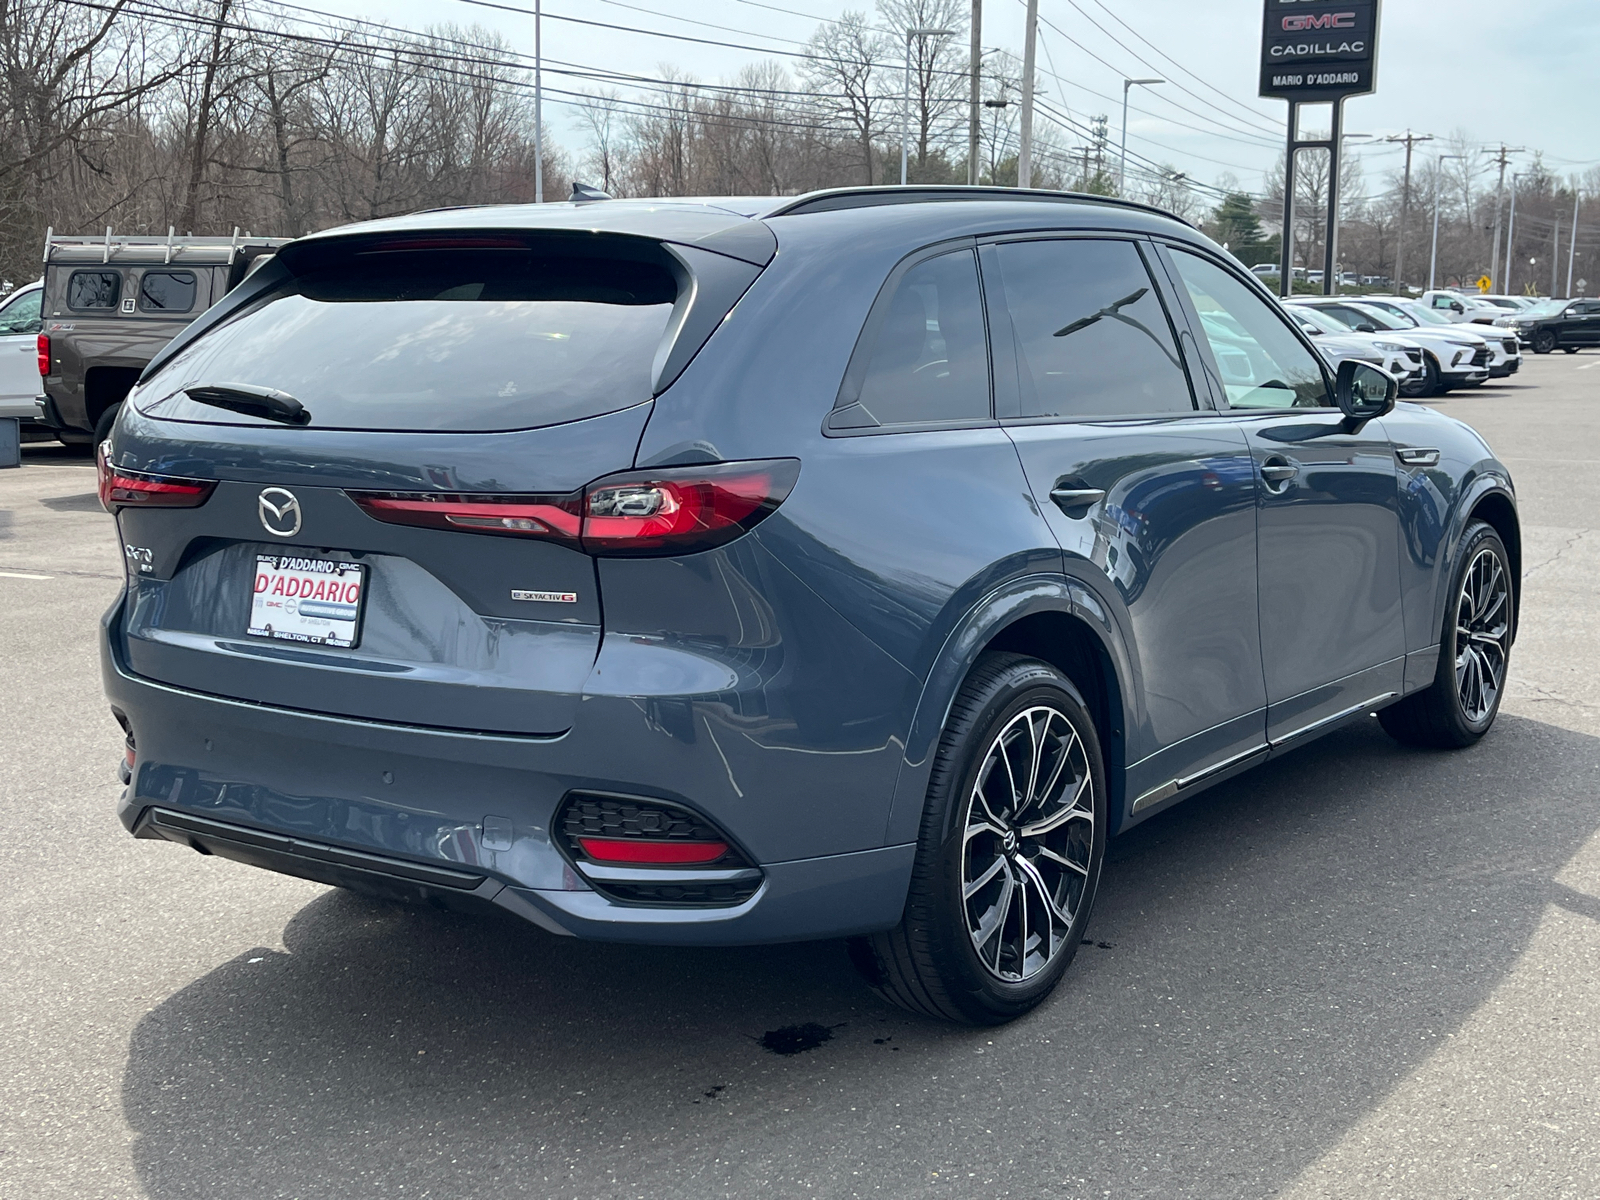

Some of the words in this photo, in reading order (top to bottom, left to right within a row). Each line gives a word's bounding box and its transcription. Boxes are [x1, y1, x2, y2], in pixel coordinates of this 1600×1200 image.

[1282, 12, 1356, 31] GMC
[1270, 41, 1364, 56] CADILLAC
[1272, 74, 1303, 86] MARIO
[1307, 72, 1359, 85] D'ADDARIO
[280, 557, 334, 573] D'ADDARIO
[339, 563, 360, 571] GMC
[254, 574, 360, 603] D'ADDARIO
[274, 632, 310, 642] SHELTON,
